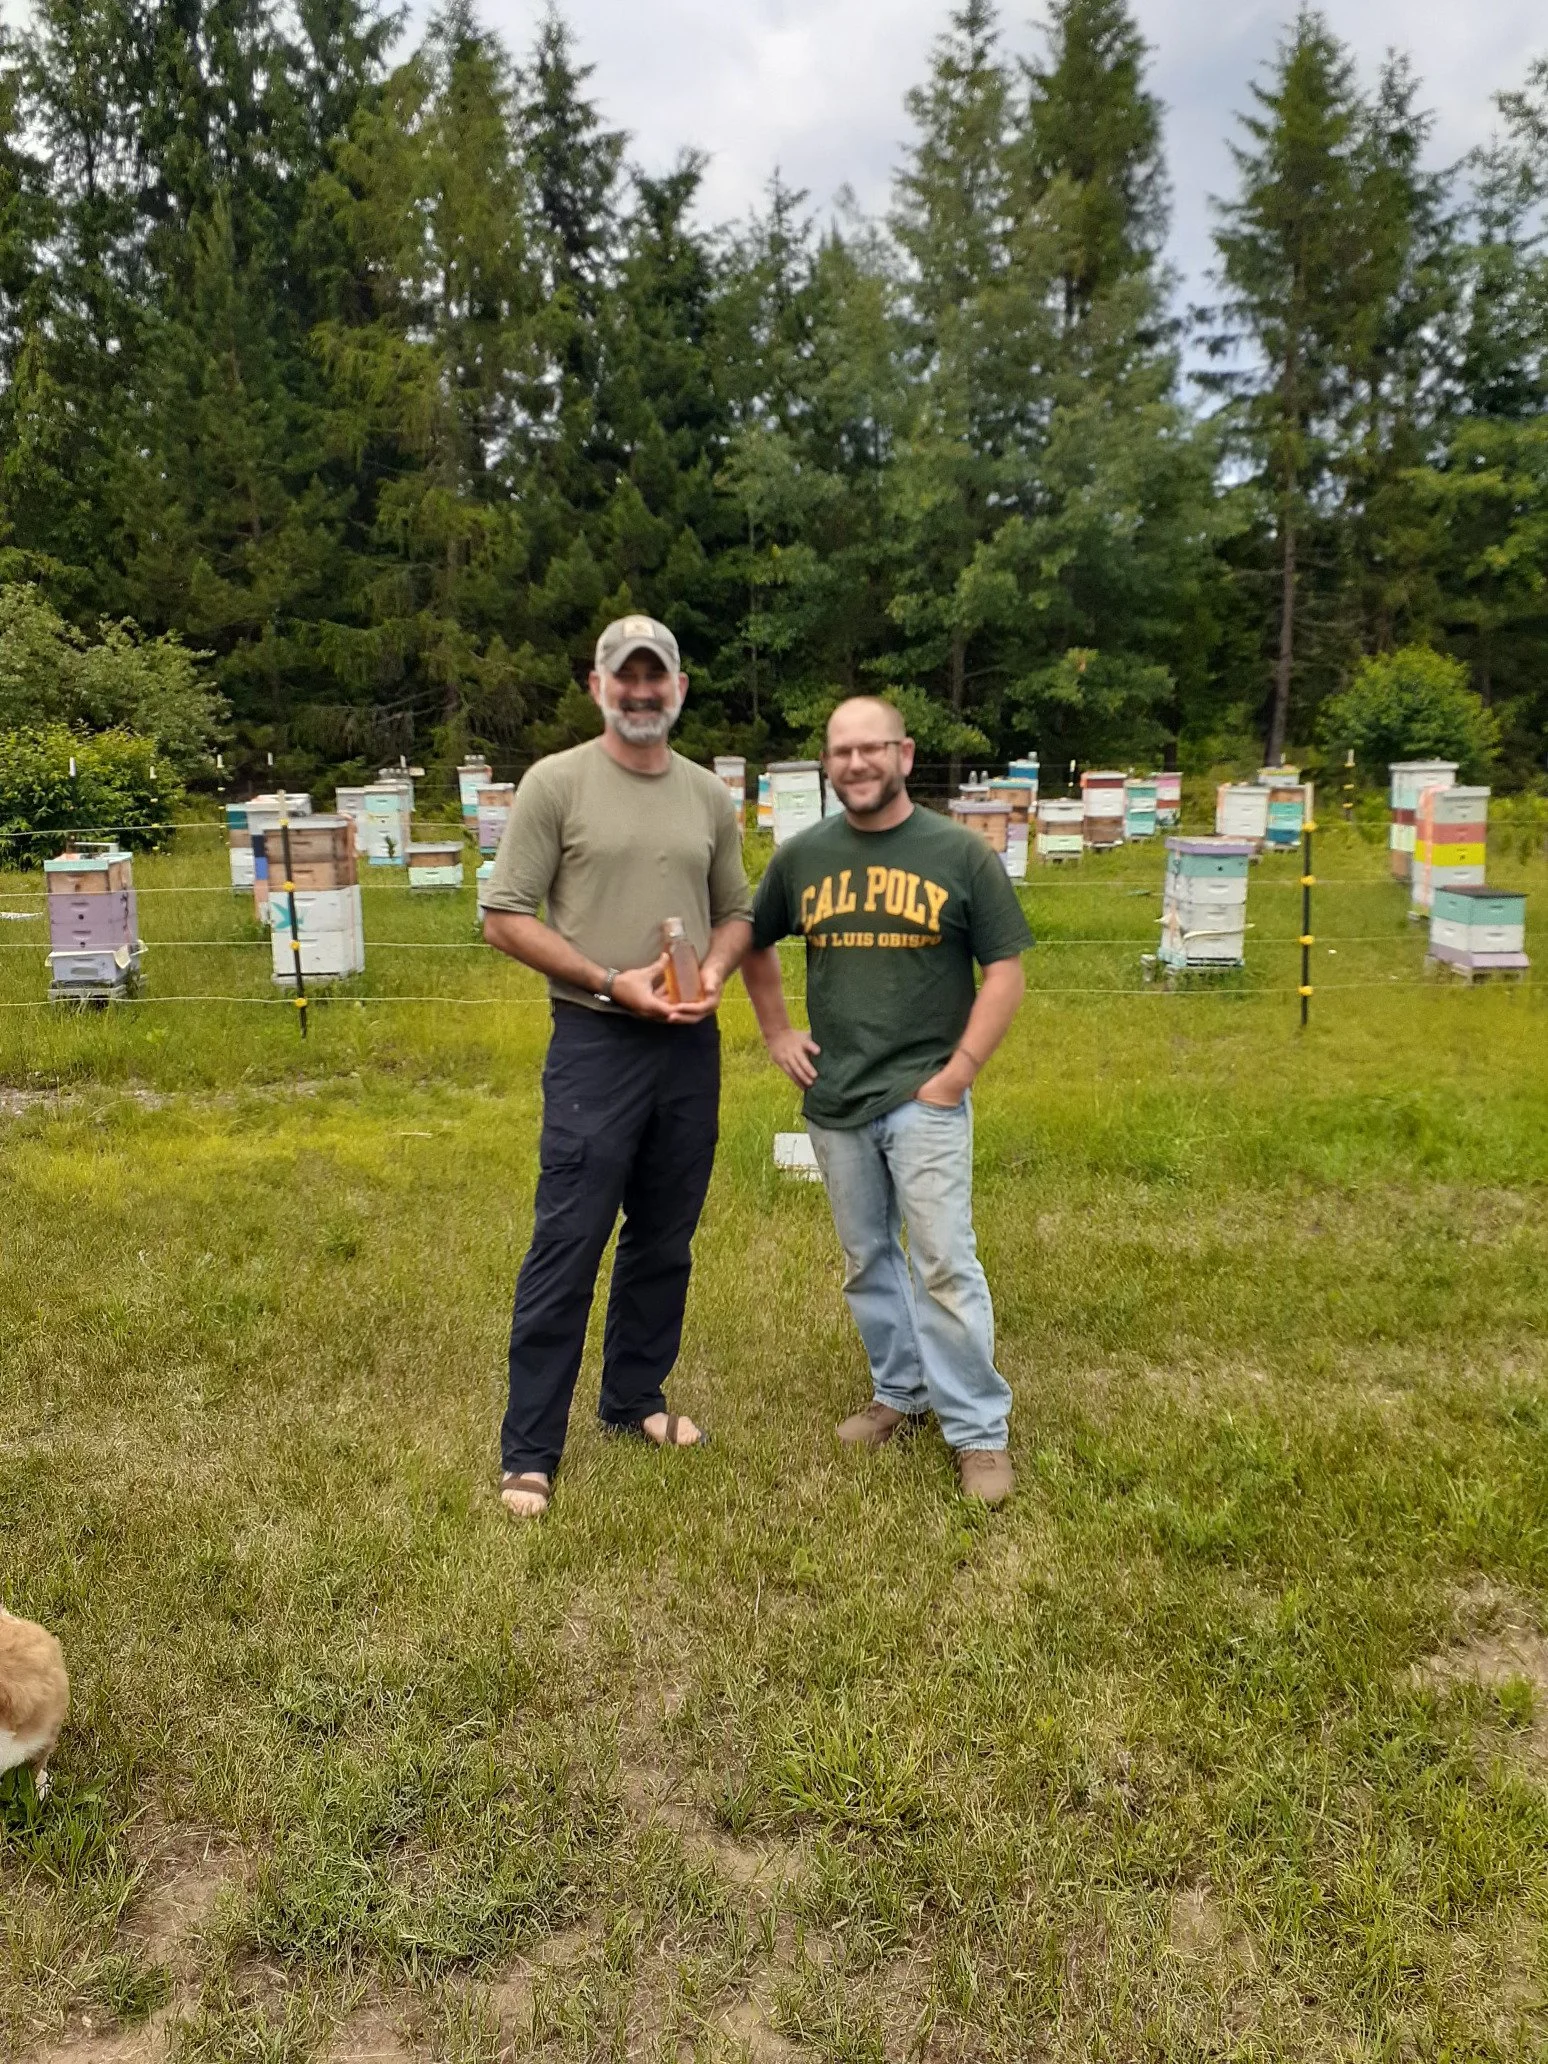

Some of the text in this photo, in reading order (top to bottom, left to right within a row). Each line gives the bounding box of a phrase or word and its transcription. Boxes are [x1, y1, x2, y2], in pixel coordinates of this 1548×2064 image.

[801, 865, 949, 933] CAL POLY
[831, 932, 874, 947] LUIS
